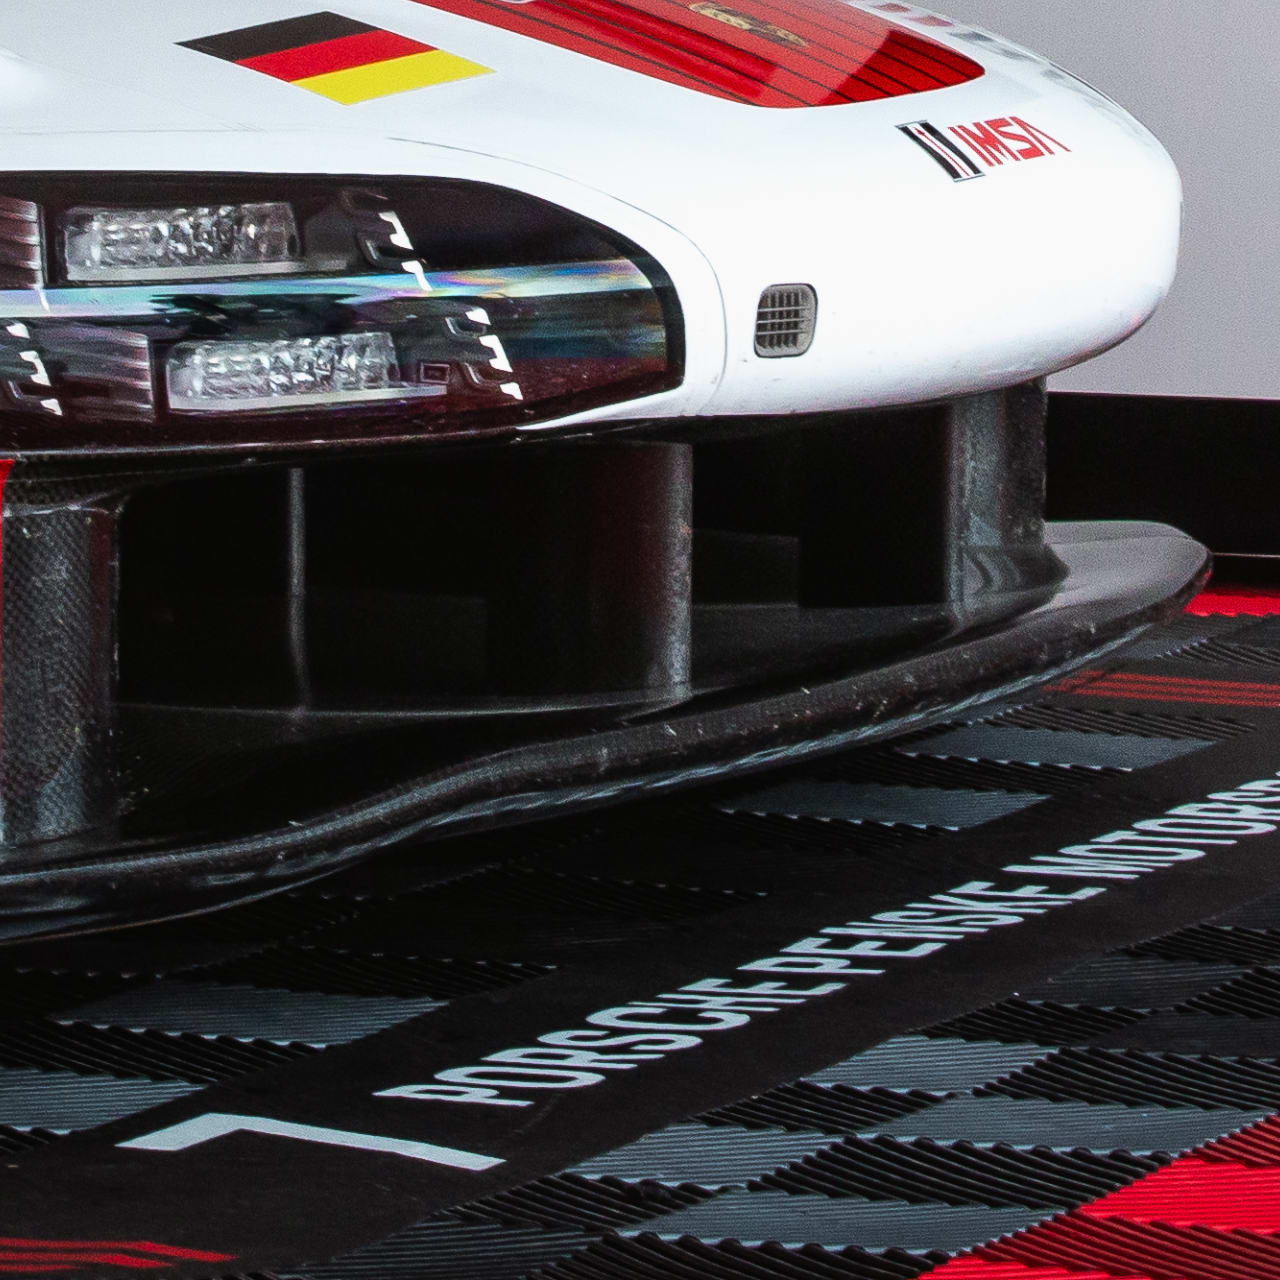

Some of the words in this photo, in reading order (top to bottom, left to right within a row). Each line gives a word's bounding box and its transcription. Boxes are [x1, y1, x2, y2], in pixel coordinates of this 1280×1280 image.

[947, 115, 1073, 167] IMSA
[372, 977, 848, 1108] PORSCHE
[736, 881, 1107, 975] PENSKE
